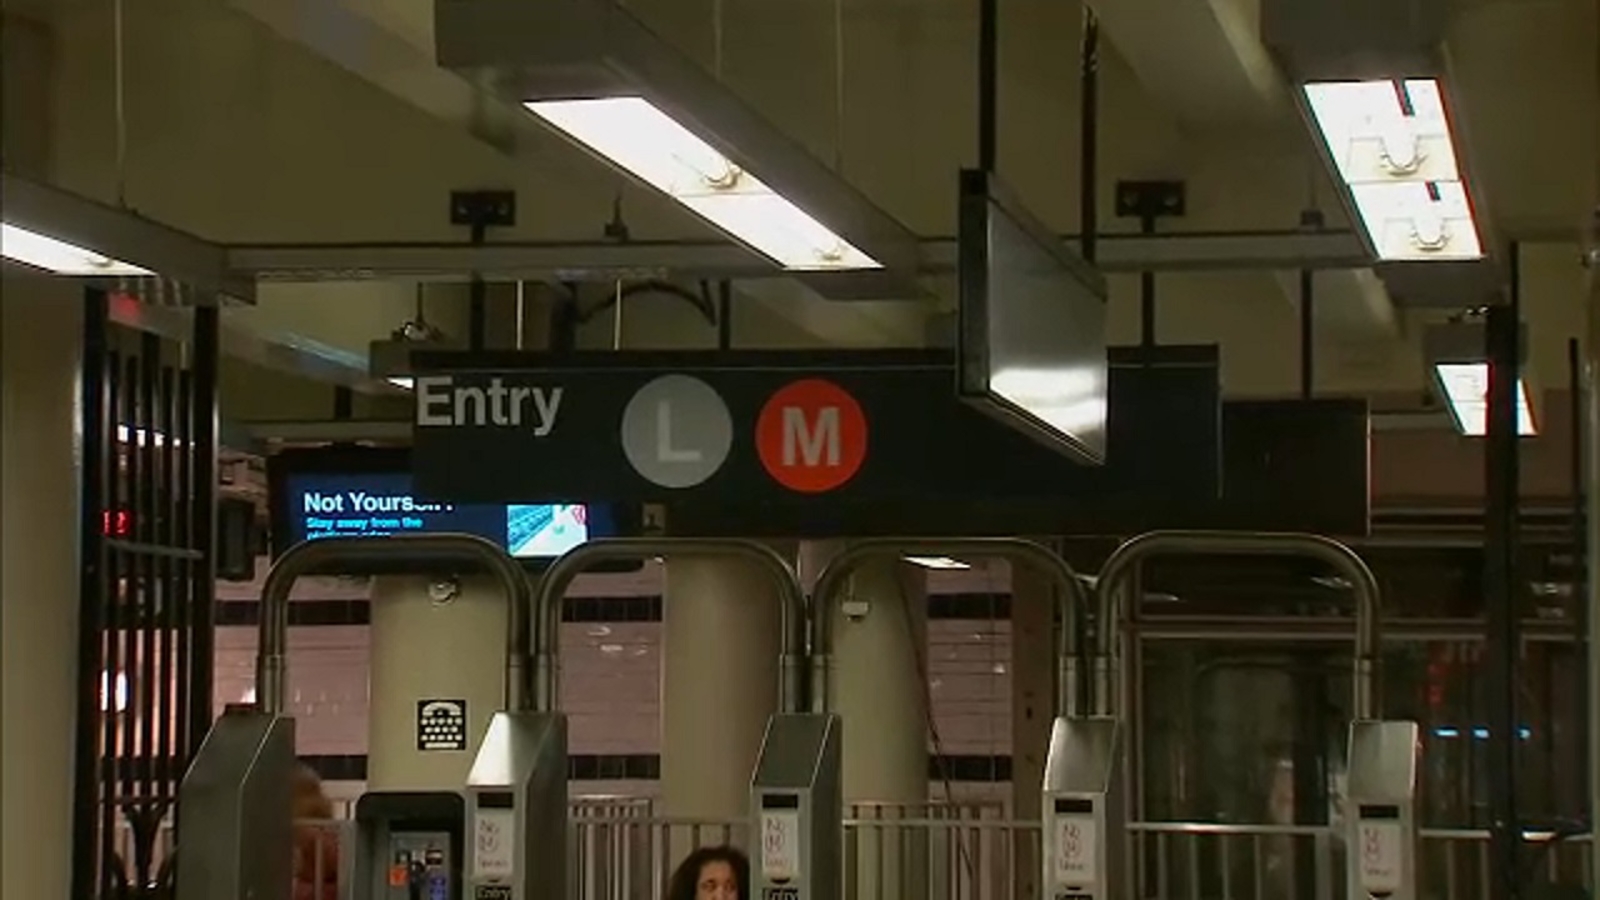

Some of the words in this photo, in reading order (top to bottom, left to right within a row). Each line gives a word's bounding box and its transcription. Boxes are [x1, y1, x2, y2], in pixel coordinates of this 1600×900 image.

[416, 376, 563, 436] Entry
[656, 400, 702, 462] L
[780, 406, 842, 467] M
[303, 492, 344, 512] Not
